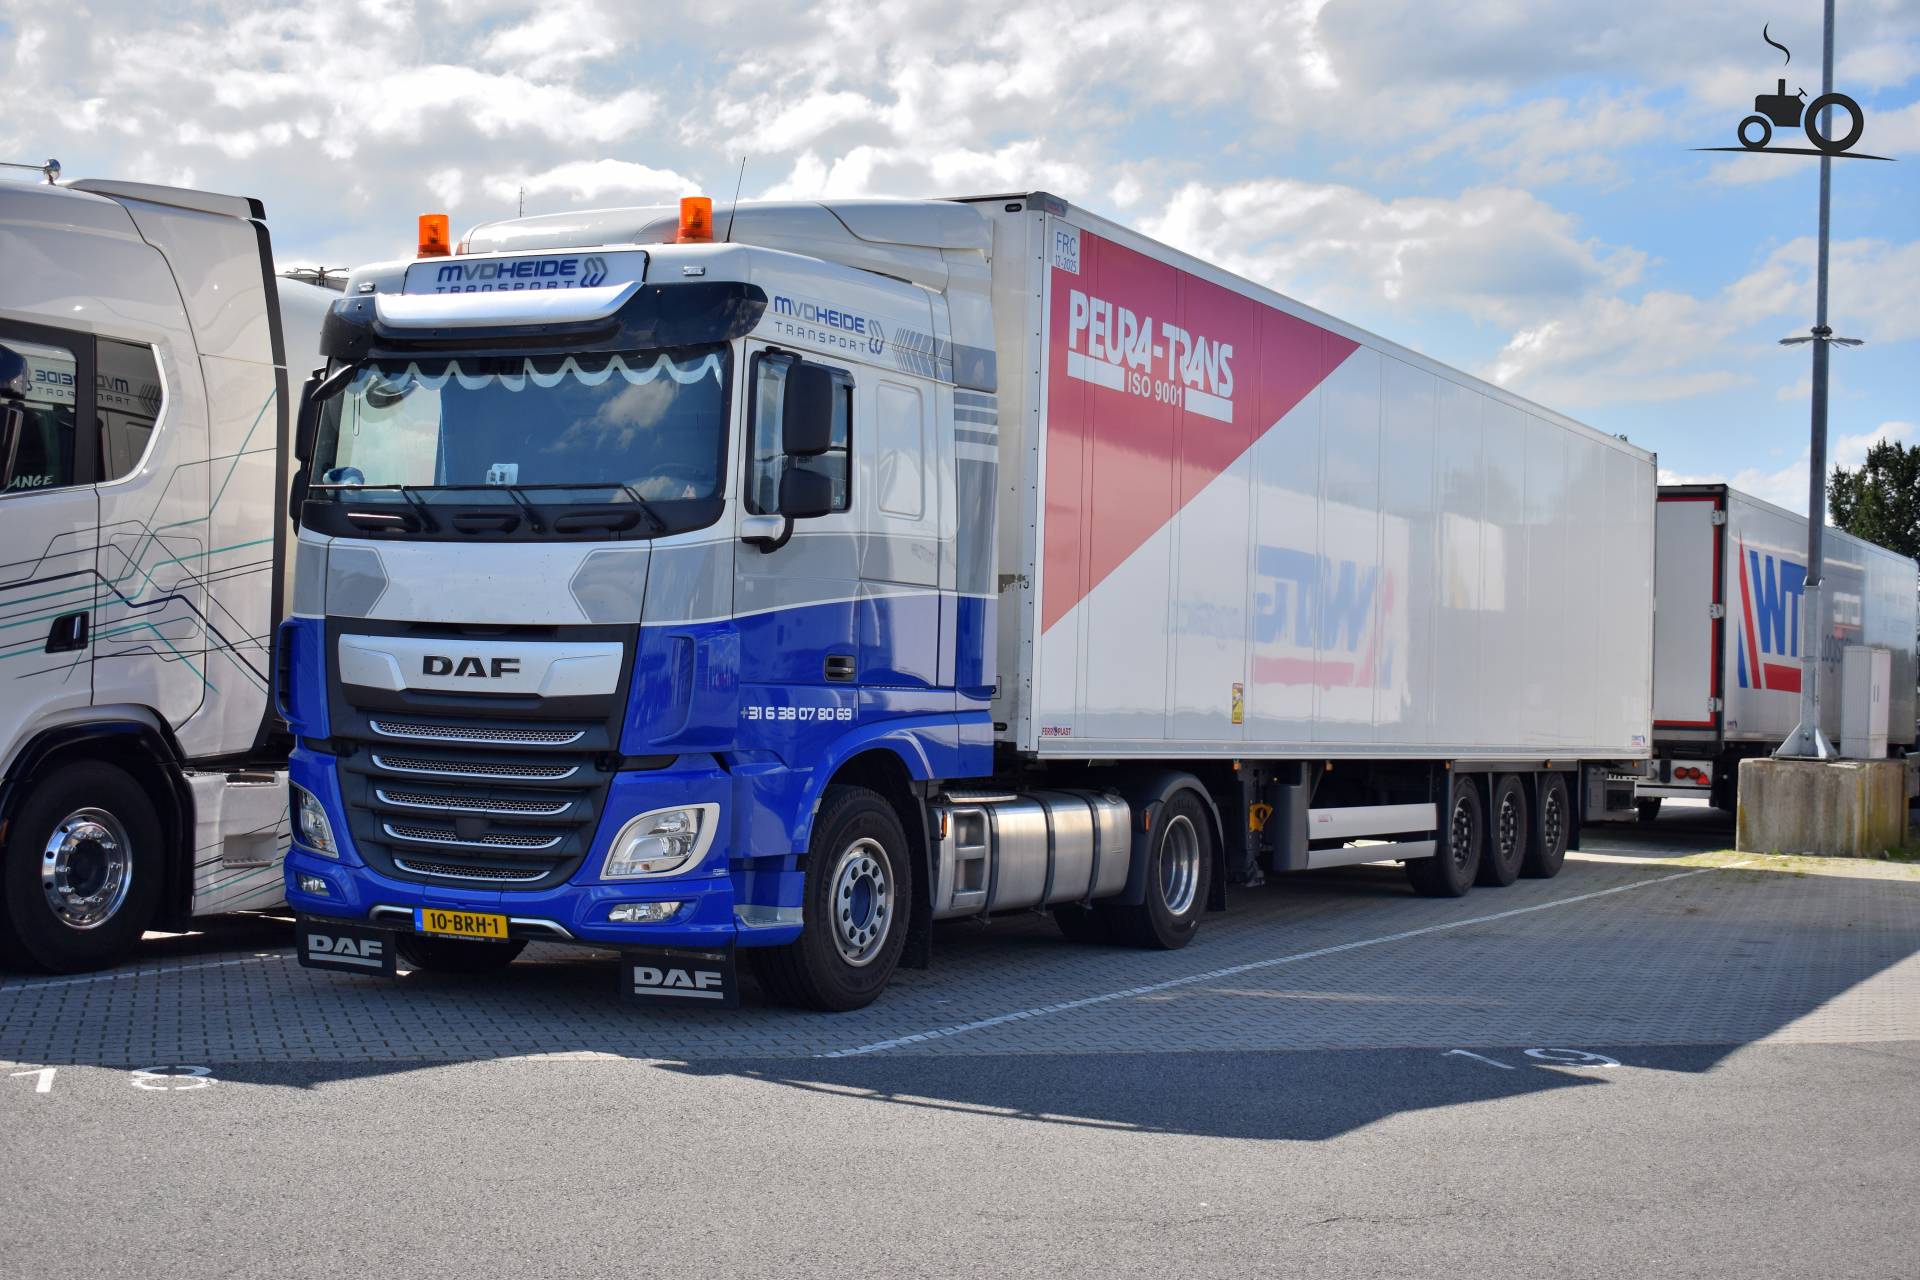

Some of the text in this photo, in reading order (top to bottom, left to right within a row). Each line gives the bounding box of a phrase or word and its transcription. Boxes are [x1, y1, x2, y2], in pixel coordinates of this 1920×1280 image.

[1056, 231, 1077, 257] FRC
[437, 259, 578, 282] MVDHEIDE
[774, 295, 866, 335] MVDHEIDE
[775, 322, 867, 353] TRANSPORT
[1068, 289, 1234, 398] PEURA-TRANS
[1128, 371, 1183, 408] ISO 9001
[423, 655, 521, 678] DAF
[765, 707, 775, 720] 6
[778, 707, 796, 720] 38
[799, 707, 815, 720] 07
[818, 708, 834, 720] 80
[836, 708, 852, 720] 69
[430, 912, 499, 934] 10-BRH-1
[307, 934, 383, 957] DAF
[633, 966, 723, 989] DAF
